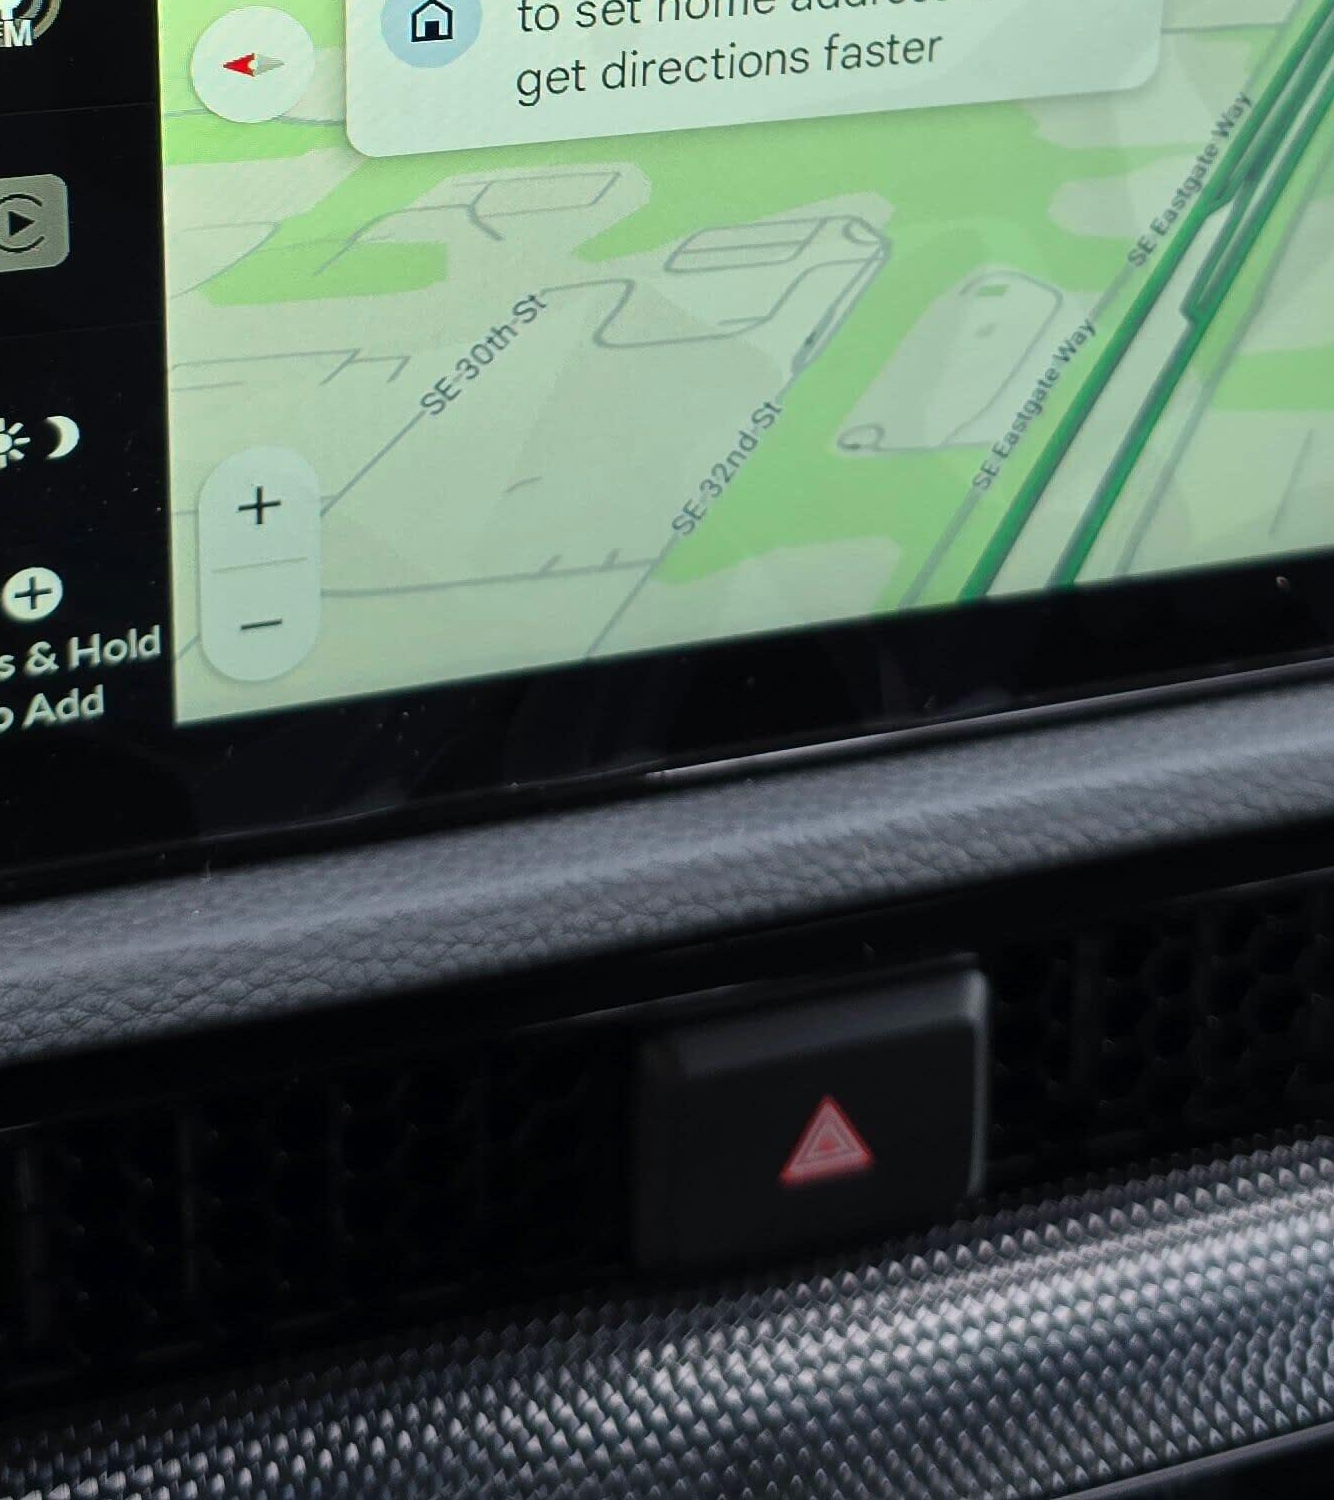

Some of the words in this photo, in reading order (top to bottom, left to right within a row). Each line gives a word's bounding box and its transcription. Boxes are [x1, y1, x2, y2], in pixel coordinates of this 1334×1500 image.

[517, 0, 560, 32] to
[516, 59, 586, 106] get
[602, 42, 810, 90] directions
[824, 33, 944, 72] faster
[1127, 235, 1157, 268] SE
[1149, 143, 1219, 237] Eastgate
[1210, 91, 1253, 138] Way
[420, 376, 462, 416] SE
[455, 324, 518, 380] 30th
[512, 294, 547, 324] St
[972, 459, 1000, 491] SE
[992, 367, 1060, 459] Eastgate
[1052, 318, 1096, 363] Way
[671, 498, 707, 536] SE
[699, 430, 758, 499] 32nd
[751, 401, 783, 430] St
[24, 640, 60, 676] &
[68, 624, 162, 669] Hold
[22, 683, 106, 729] Add
